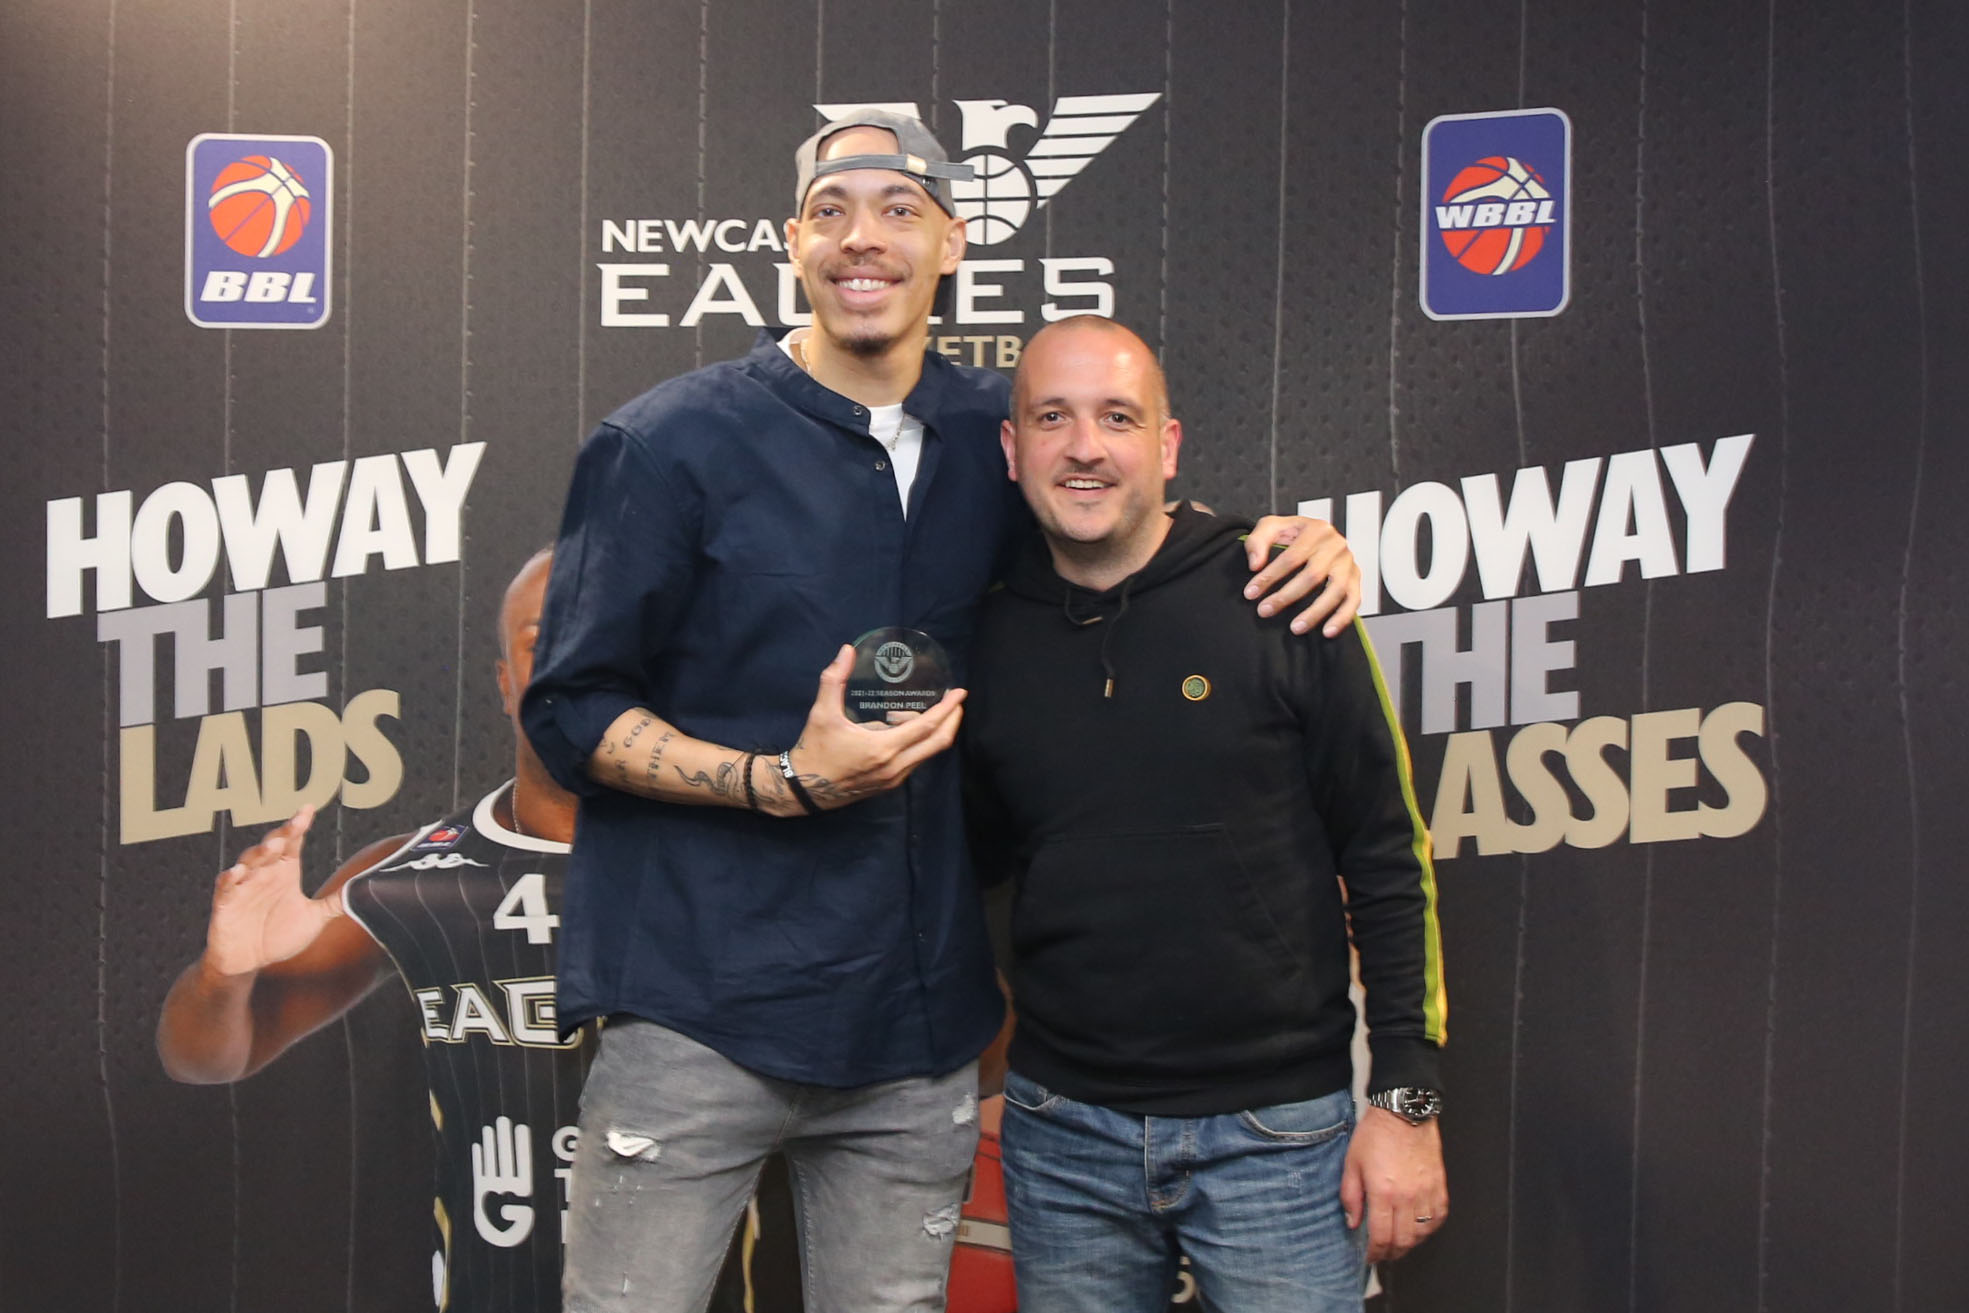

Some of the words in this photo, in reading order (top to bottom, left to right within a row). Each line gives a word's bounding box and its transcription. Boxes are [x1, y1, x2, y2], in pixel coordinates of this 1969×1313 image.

[602, 219, 789, 252] NEWCA
[1435, 200, 1557, 229] WBBL
[200, 270, 317, 303] BBL
[596, 256, 1115, 328] EAES
[47, 441, 487, 619] HOWAY
[1297, 433, 1755, 617] HOWAY
[97, 581, 327, 727] THE
[1359, 590, 1580, 735] THE
[859, 701, 904, 710] BRANDON
[905, 701, 927, 710] PEEL
[120, 688, 404, 845] LADS
[779, 750, 794, 779] BLAC
[1430, 701, 1767, 860] ASSES
[493, 873, 561, 944] 4
